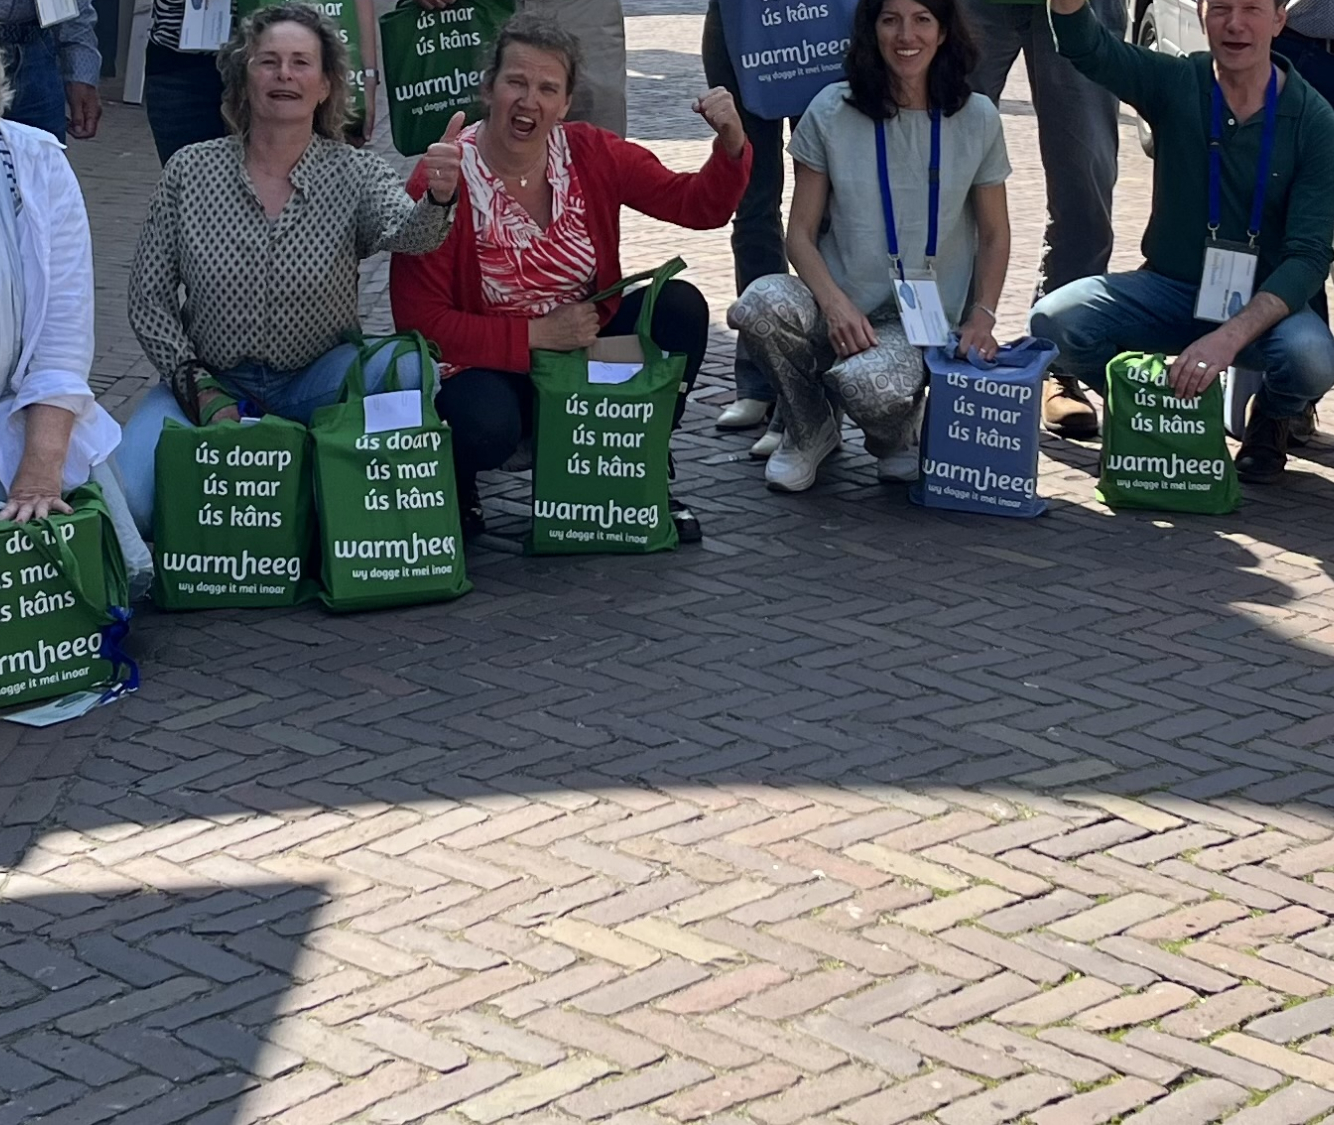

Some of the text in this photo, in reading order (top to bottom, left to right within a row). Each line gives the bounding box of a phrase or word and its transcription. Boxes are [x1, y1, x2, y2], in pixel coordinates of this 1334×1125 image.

[416, 5, 475, 31] ús mar
[761, 2, 829, 26] ús kâns
[416, 28, 481, 57] ús kâns
[974, 376, 1032, 404] doarp
[1134, 387, 1156, 407] ús
[566, 393, 653, 423] ús doarp
[953, 396, 1021, 425] ús mar
[572, 423, 645, 448] ús mar
[1131, 412, 1206, 434] ús kâns
[386, 431, 442, 452] doarp
[948, 422, 1021, 451] ús kâns
[195, 442, 292, 472] ús doarp
[366, 458, 439, 480] ús mar
[567, 452, 646, 478] ús kâns
[203, 473, 280, 497] ús mar
[364, 487, 445, 511] ús kâns
[198, 503, 282, 527] ús kâns
[534, 499, 659, 528] warmheeg
[549, 529, 564, 540] wy
[566, 528, 595, 542] dogge
[596, 529, 604, 540] it
[20, 560, 64, 585] ma
[163, 550, 301, 582] warmheeg
[352, 569, 368, 581] wy
[369, 567, 400, 581] dogge
[402, 566, 410, 578] it
[412, 565, 430, 577] mei
[178, 581, 286, 595] wy dogge it mei inoar
[19, 590, 75, 618] kâns
[28, 678, 37, 688] it
[39, 674, 60, 686] mei
[61, 666, 91, 681] inoar
